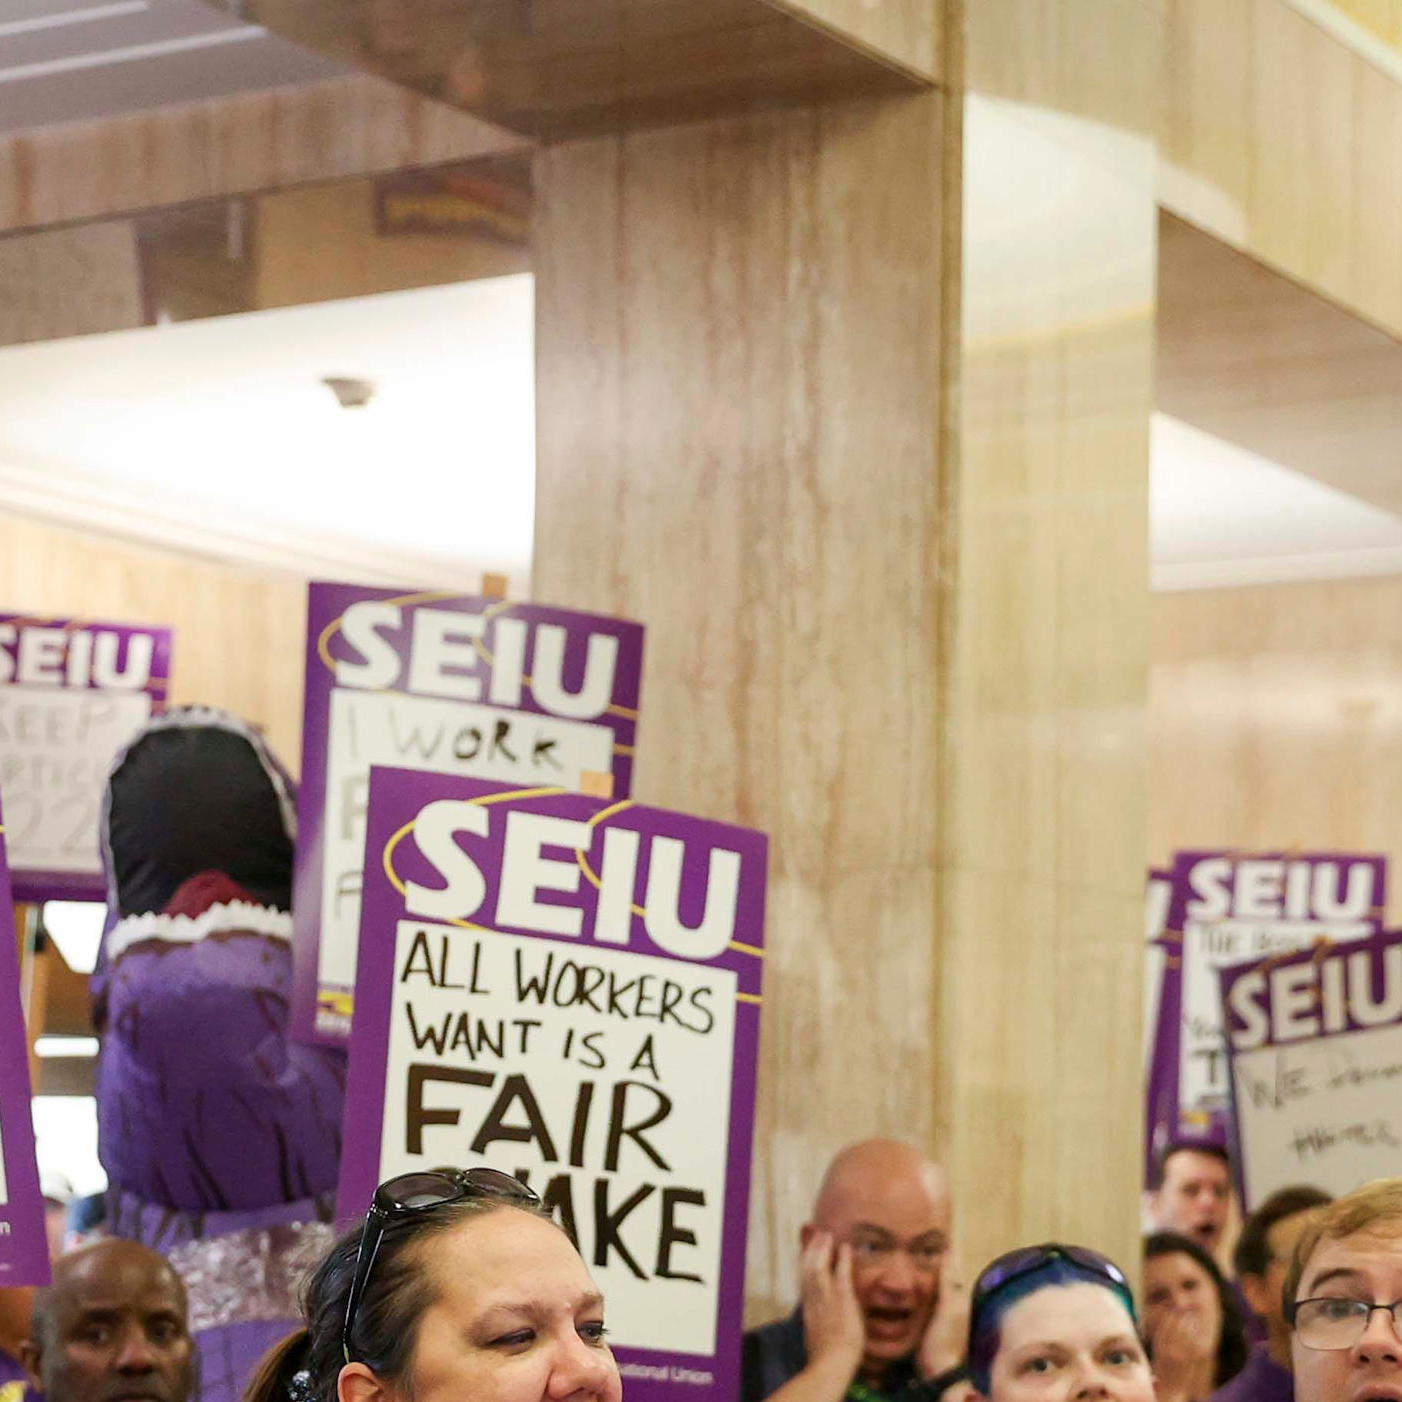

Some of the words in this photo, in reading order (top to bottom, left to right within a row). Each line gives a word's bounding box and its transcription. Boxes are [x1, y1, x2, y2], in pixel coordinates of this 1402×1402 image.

[336, 601, 619, 720] SEIU
[390, 706, 565, 772] WORK
[404, 800, 741, 960] SEIU
[1185, 858, 1374, 922] SEIU
[402, 931, 490, 995] ALL
[515, 948, 714, 1034] WORKERS
[406, 1002, 542, 1061] WANT
[563, 1028, 606, 1069] IS
[630, 1034, 661, 1081] A
[406, 1063, 673, 1172] FAIR
[428, 1167, 706, 1284] AKE
